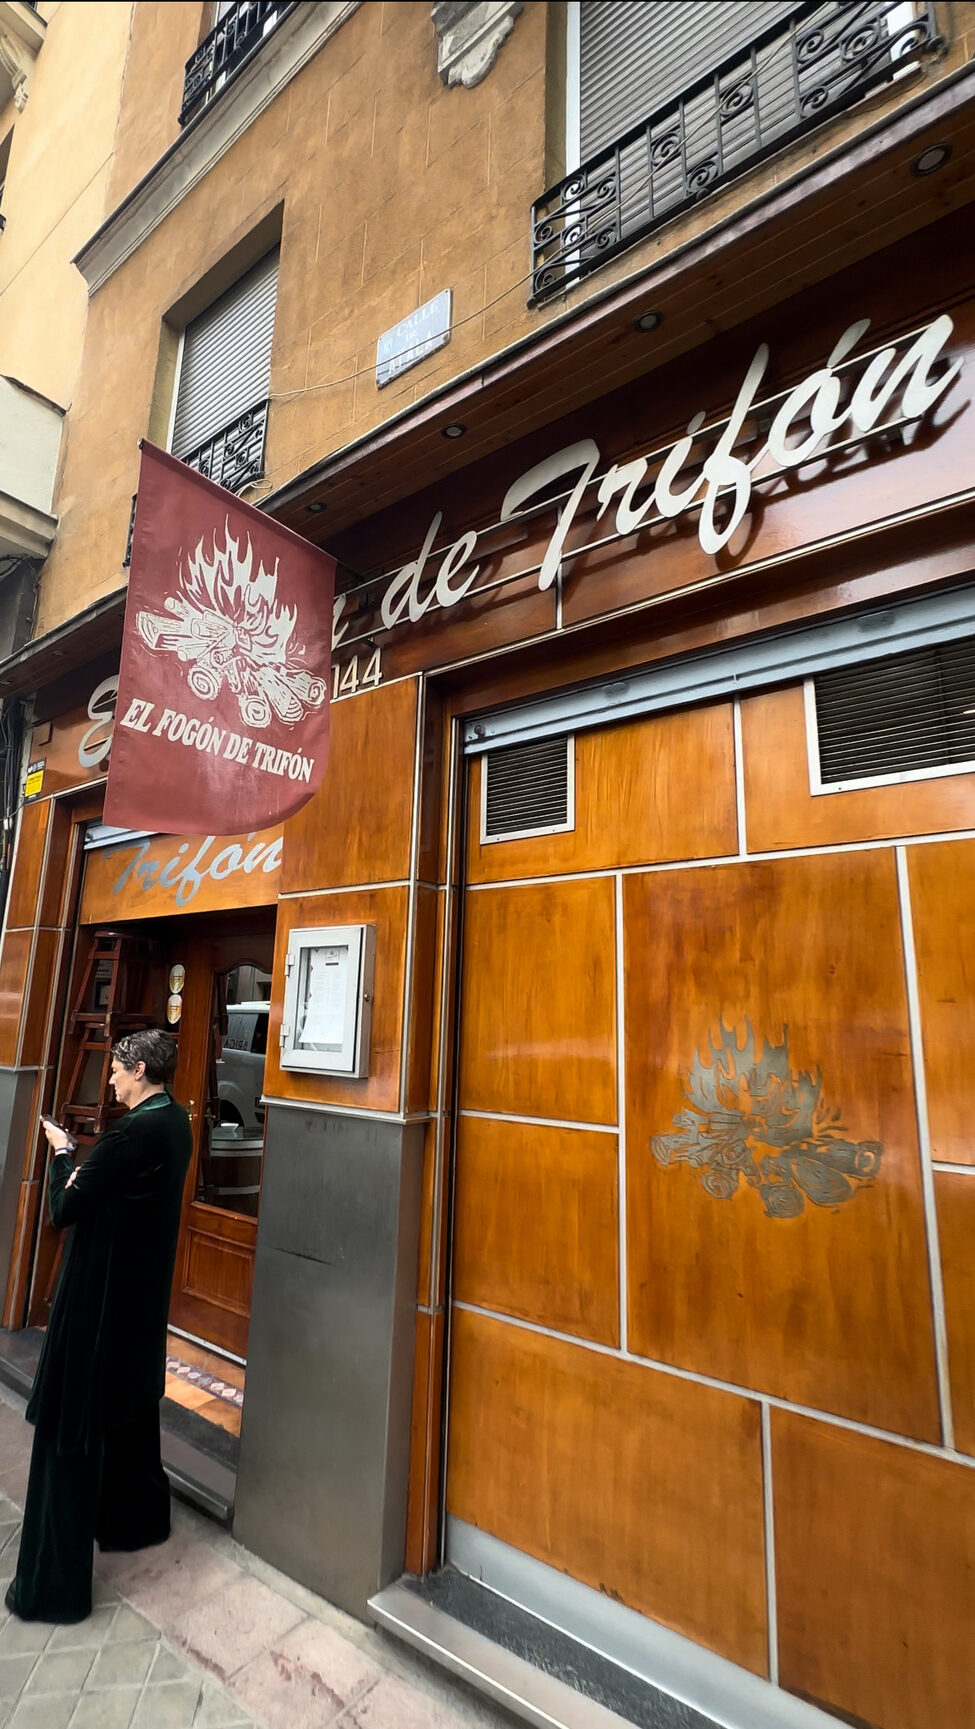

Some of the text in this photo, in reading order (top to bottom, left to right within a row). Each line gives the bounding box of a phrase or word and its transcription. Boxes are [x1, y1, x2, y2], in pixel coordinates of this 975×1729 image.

[396, 300, 439, 337] CALLE
[381, 511, 480, 630] de
[501, 314, 964, 592] Trifón
[331, 647, 383, 699] 144
[120, 698, 315, 783] EL FOGÓN DE TRIFÓN
